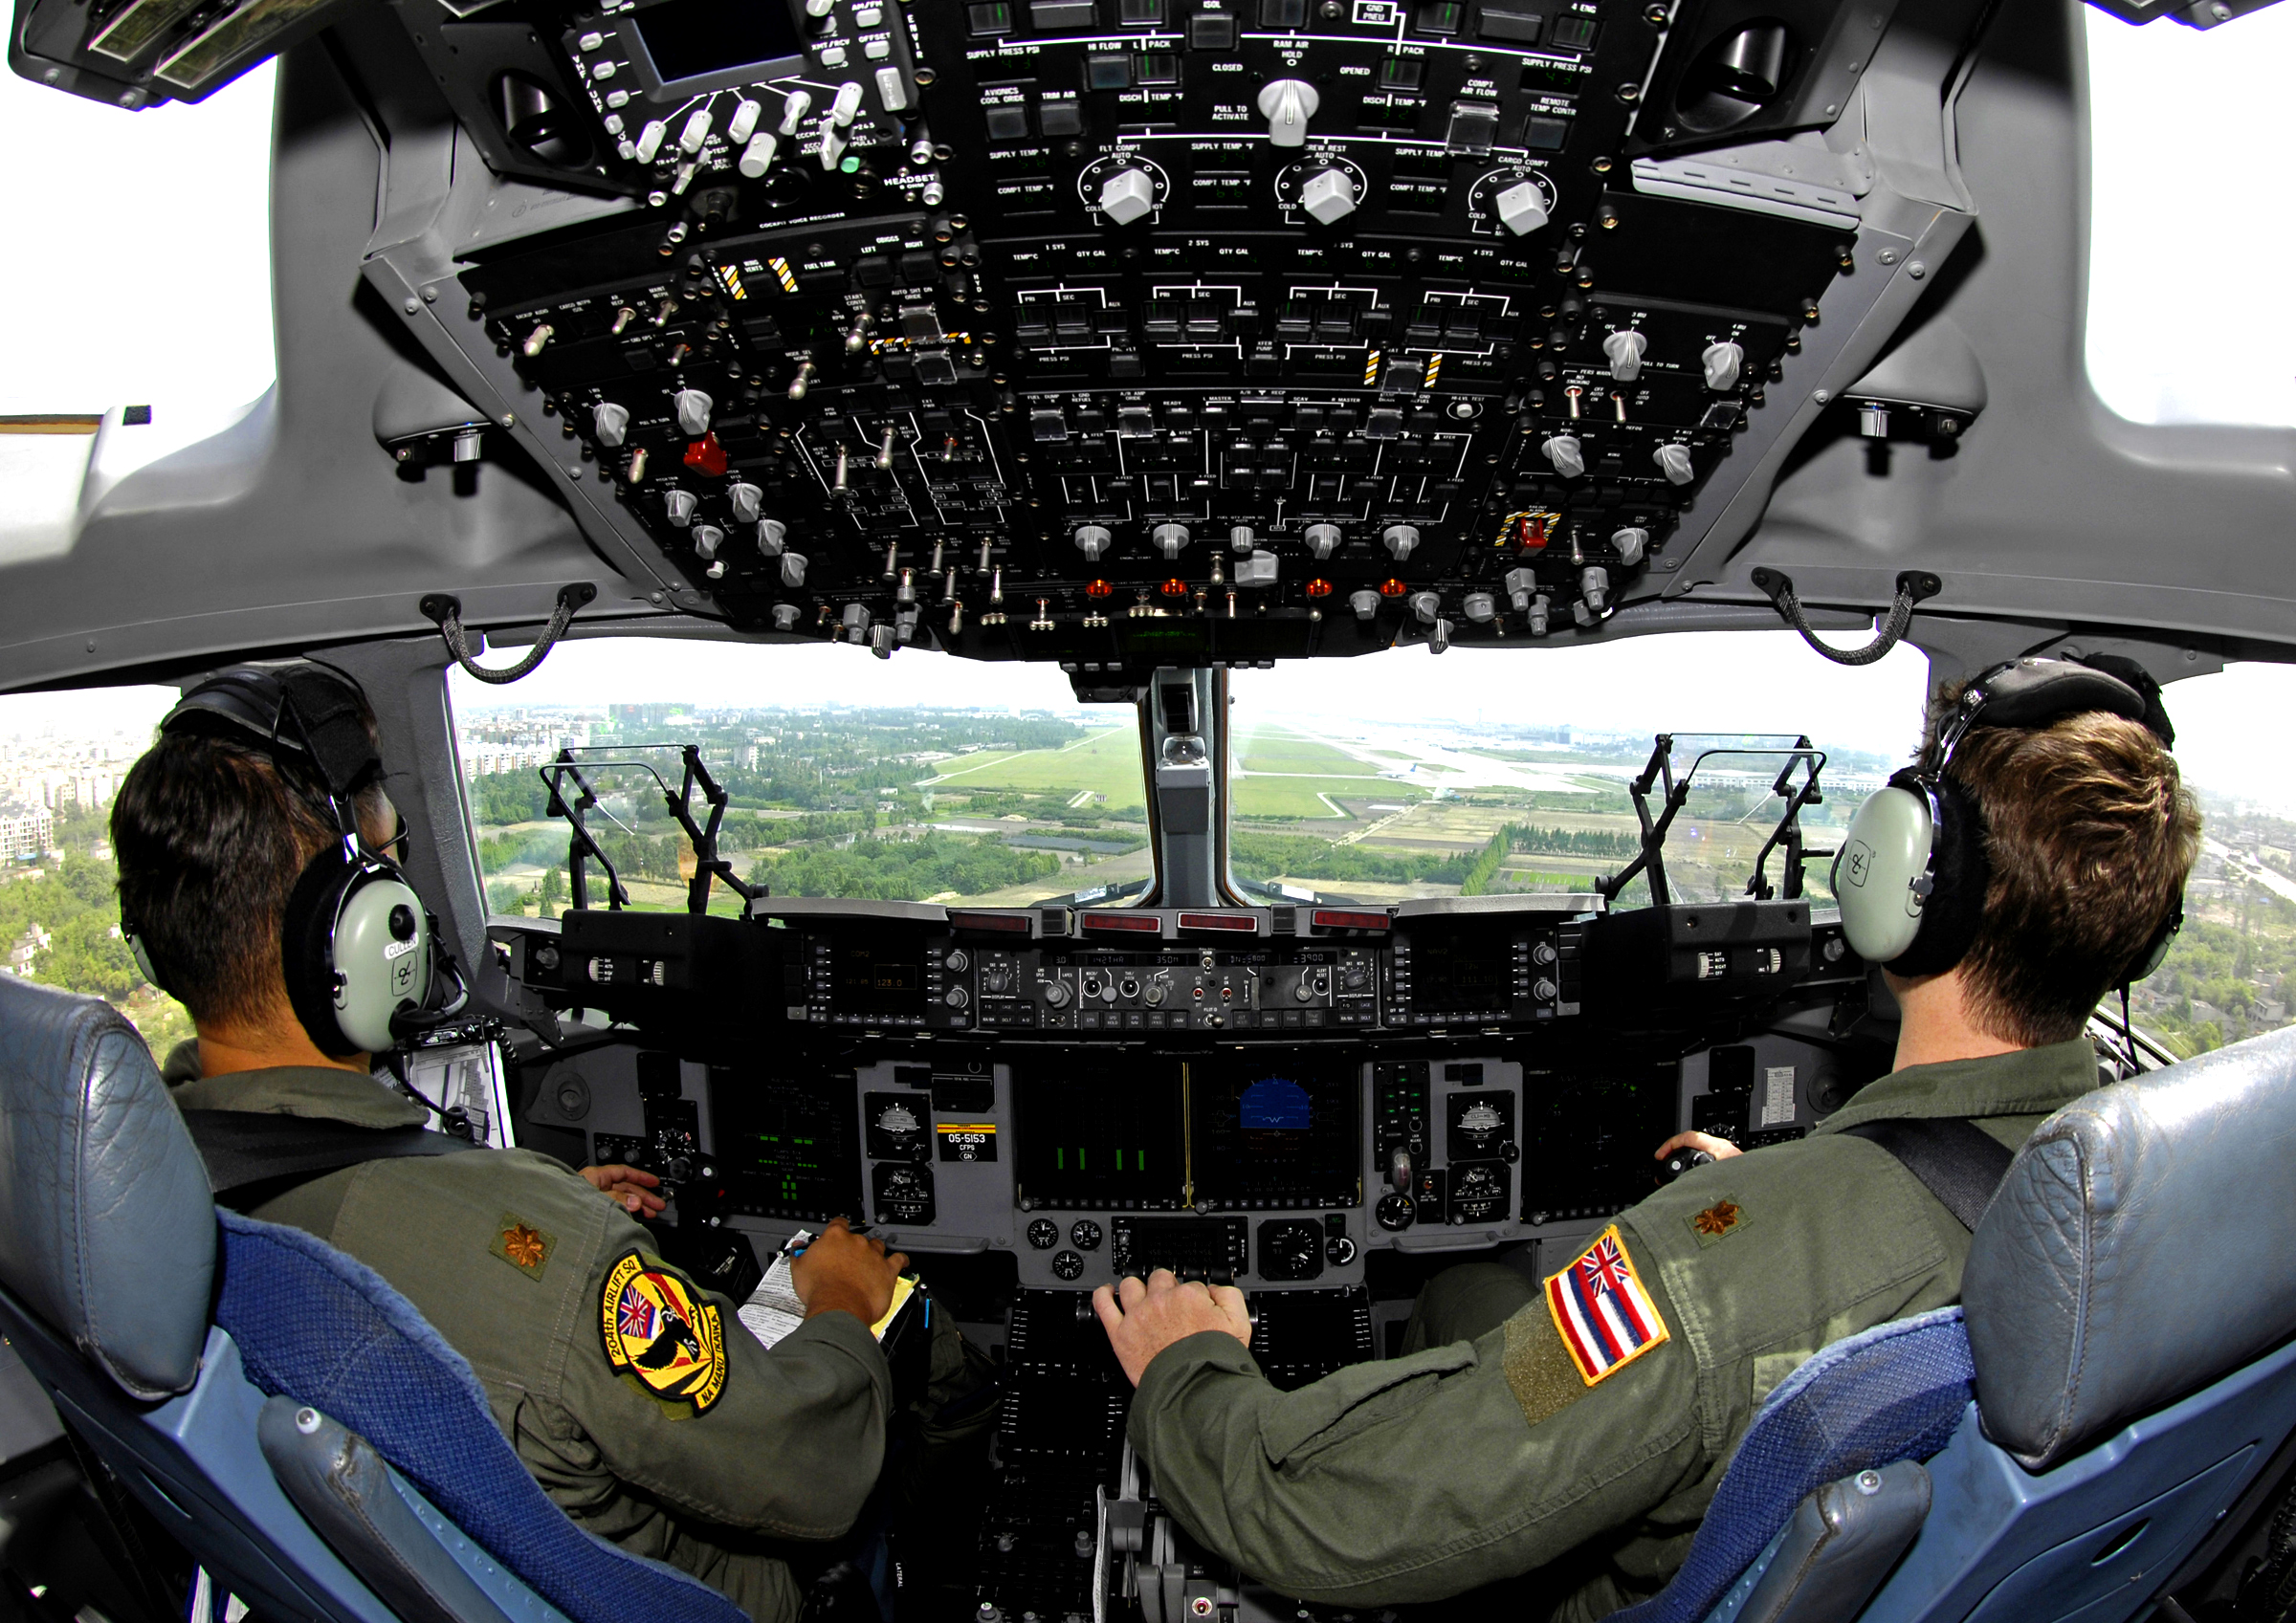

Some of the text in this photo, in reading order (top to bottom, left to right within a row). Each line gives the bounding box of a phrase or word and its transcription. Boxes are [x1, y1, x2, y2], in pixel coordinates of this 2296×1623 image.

[1366, 4, 1383, 12] GND
[1581, 4, 1596, 12] ENG
[1362, 12, 1385, 21] PNEU
[858, 32, 892, 43] OFFSET
[907, 14, 923, 58] ENVIR
[811, 38, 850, 51] XMT/RCV
[966, 51, 997, 59] SUPPLY
[1000, 48, 1024, 57] PRESS
[1521, 58, 1551, 68] SUPPLY
[1554, 62, 1577, 71] PRESS
[1340, 67, 1370, 76] OPENED
[1468, 79, 1493, 88] COMPT
[984, 88, 1019, 97] AVIONICS
[1476, 88, 1497, 97] FLOW
[981, 94, 1026, 104] COOL ORIDE
[1541, 98, 1570, 107] REMOTE
[1531, 103, 1577, 116] TEMP CONTR
[1212, 113, 1248, 121] ACTIVATE
[989, 151, 1016, 160] SUPPLY
[1498, 156, 1521, 164] CARGO
[884, 173, 936, 186] HEADSET
[1025, 185, 1044, 193] TEMP
[1390, 184, 1414, 192] COMPT
[810, 212, 845, 222] RECORDER
[388, 936, 416, 956] CULLEN
[948, 1133, 985, 1143] 05-5153
[605, 1260, 636, 1358] 204th AIRLIFT SQ
[701, 1391, 715, 1404] NA
[714, 1357, 724, 1389] MANU
